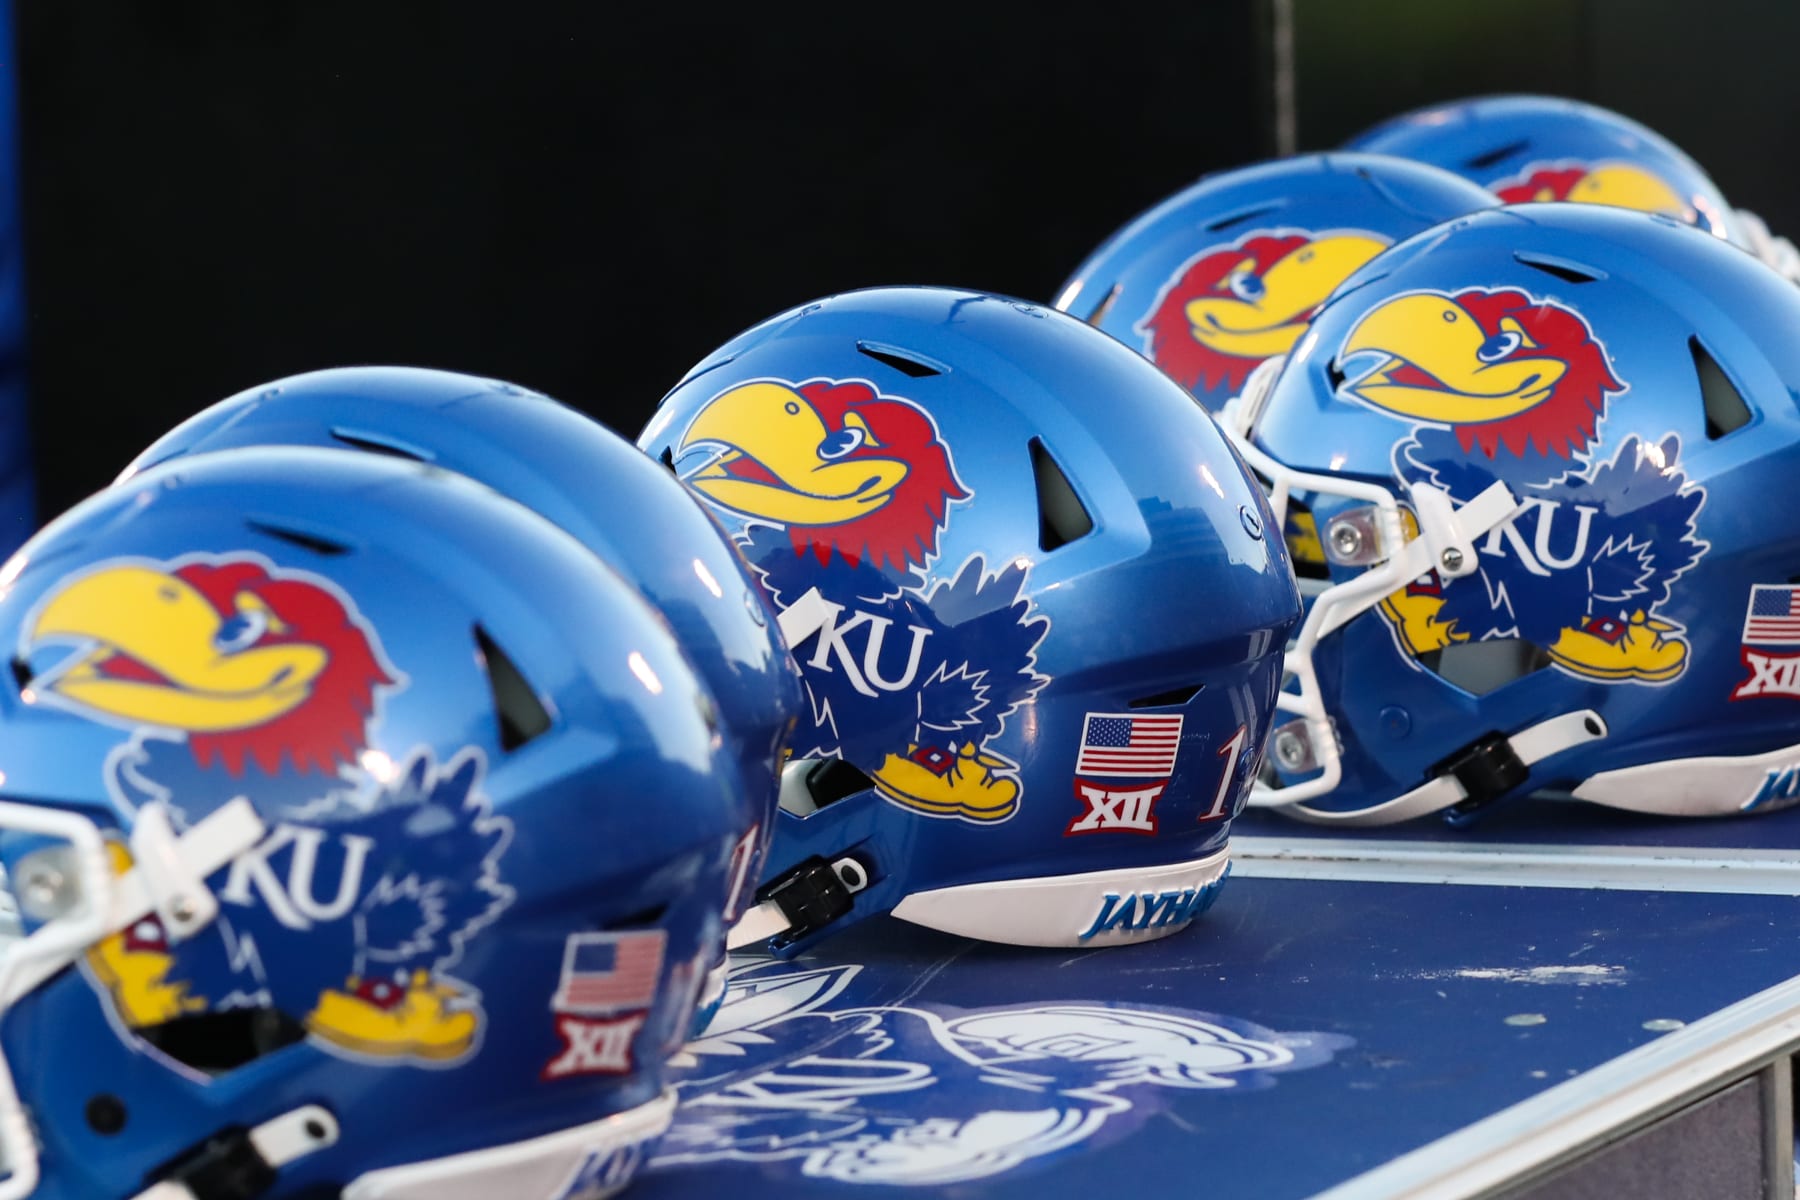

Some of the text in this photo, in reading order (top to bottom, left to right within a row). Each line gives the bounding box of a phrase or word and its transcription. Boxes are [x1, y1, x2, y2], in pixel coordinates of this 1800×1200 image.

[1480, 496, 1599, 577] KU
[806, 599, 934, 698] KU
[1070, 785, 1164, 832] XII
[218, 822, 376, 931] KU
[548, 1016, 642, 1075] XII
